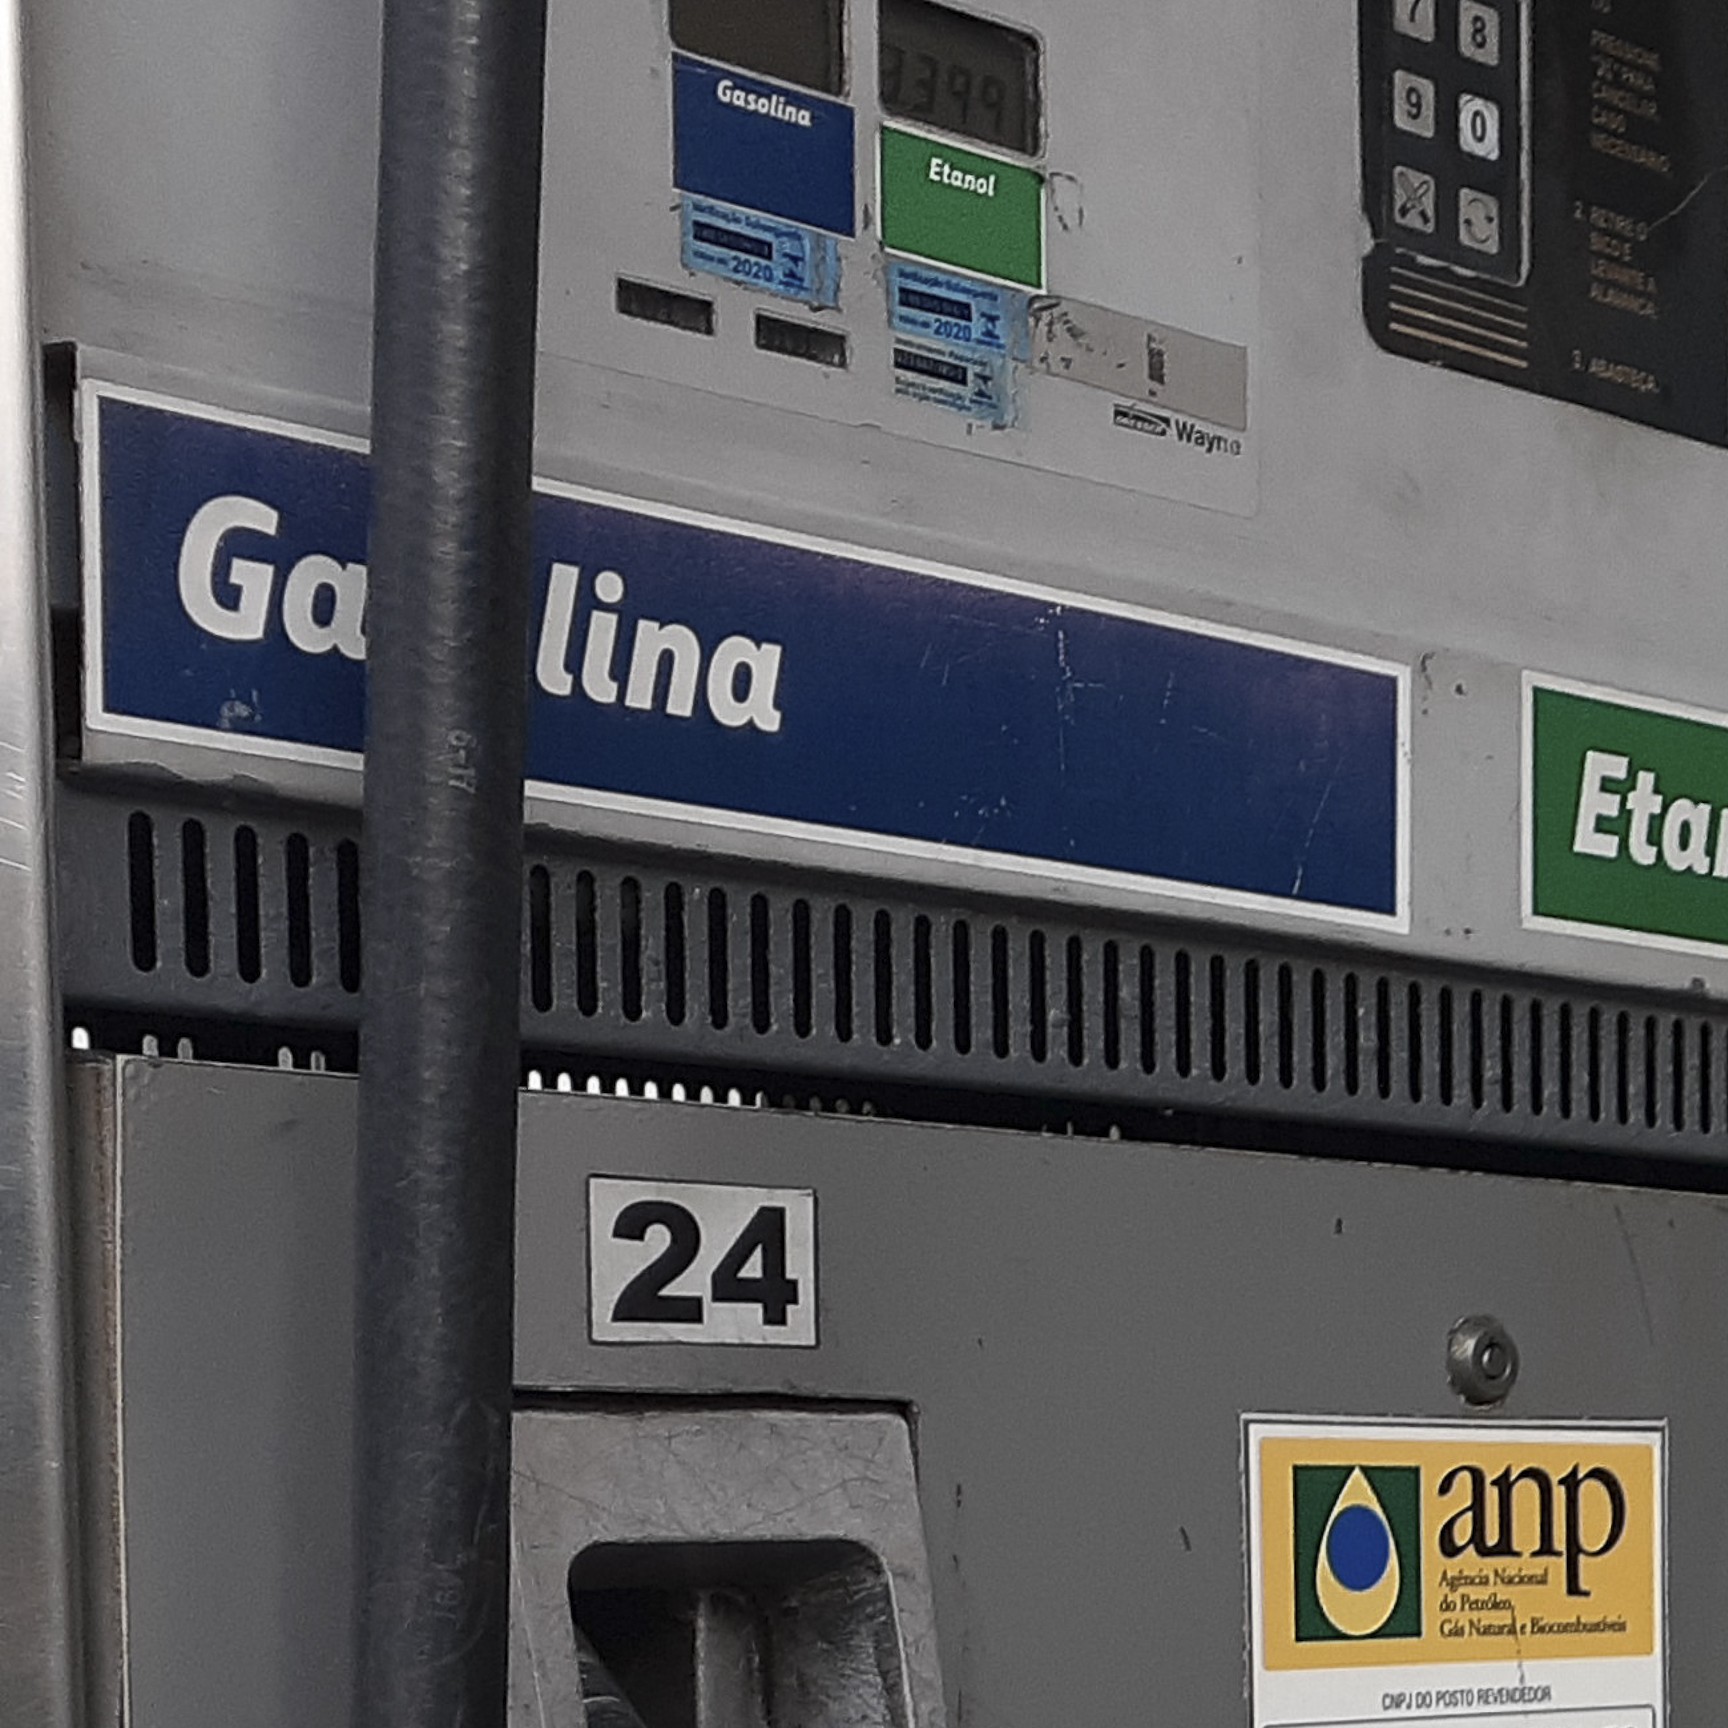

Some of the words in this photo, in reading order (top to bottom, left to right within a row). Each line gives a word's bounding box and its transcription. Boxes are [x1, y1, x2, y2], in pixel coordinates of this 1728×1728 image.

[1470, 14, 1487, 50] 8
[716, 79, 812, 127] Gasolina
[1405, 86, 1422, 121] 9
[1471, 109, 1487, 144] 0
[929, 156, 996, 198] Etanol
[731, 255, 774, 282] 2020
[933, 318, 972, 342] 2020
[178, 495, 783, 734] Galina
[609, 1199, 801, 1328] 24
[1437, 1461, 1627, 1598] anp
[1439, 1568, 1489, 1591] Agência
[1494, 1566, 1548, 1586] Nacional
[1439, 1592, 1456, 1612] do
[1440, 1619, 1465, 1638] Gás
[1469, 1617, 1514, 1638] Natural
[1519, 1621, 1527, 1635] e
[1530, 1615, 1627, 1636] Biocombustíveis
[1382, 1692, 1412, 1711] CNPJ
[1415, 1691, 1432, 1709] DO
[1436, 1688, 1474, 1708] POSTO
[1477, 1684, 1552, 1705] REVENDEDOR
